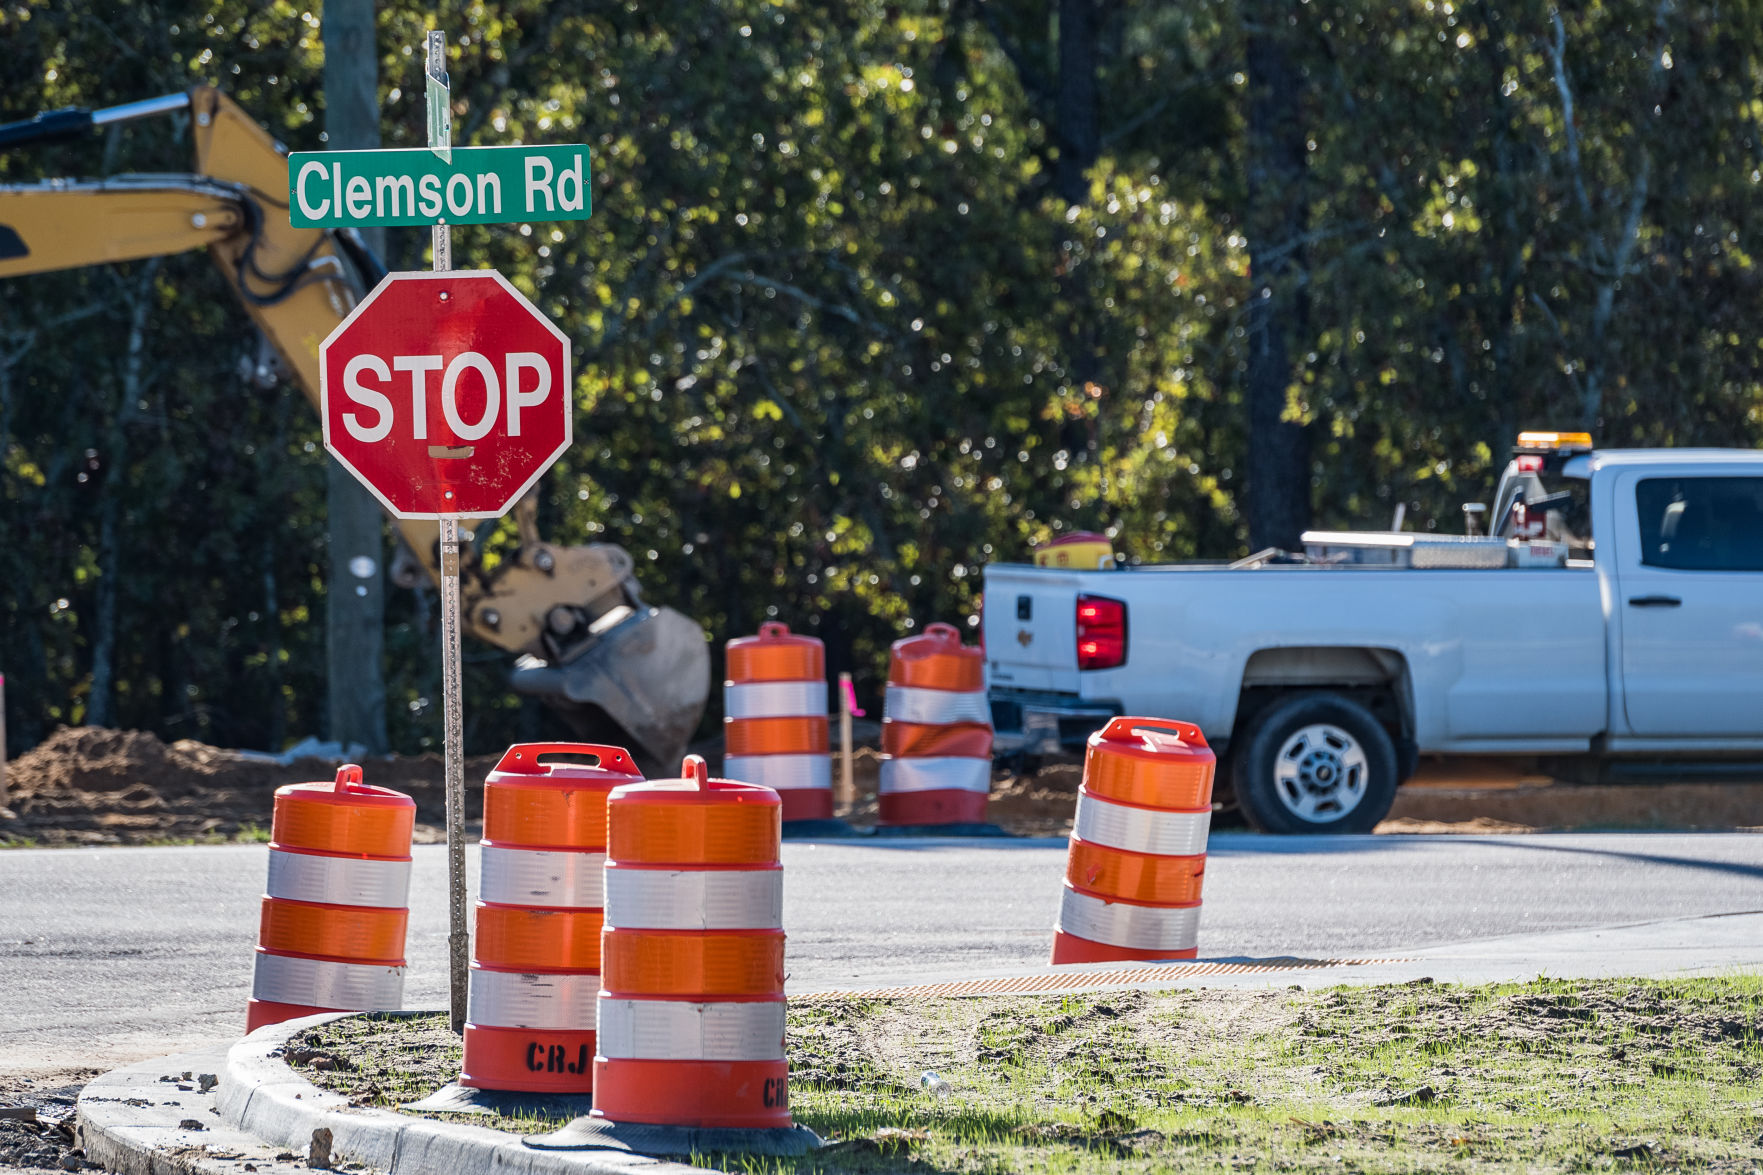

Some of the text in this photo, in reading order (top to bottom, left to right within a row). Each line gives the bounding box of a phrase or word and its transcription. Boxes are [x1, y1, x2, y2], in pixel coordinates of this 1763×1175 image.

[296, 154, 584, 221] Clemson Rd
[342, 352, 552, 443] STOP
[527, 1042, 587, 1074] CRJ
[763, 1077, 788, 1108] CR
